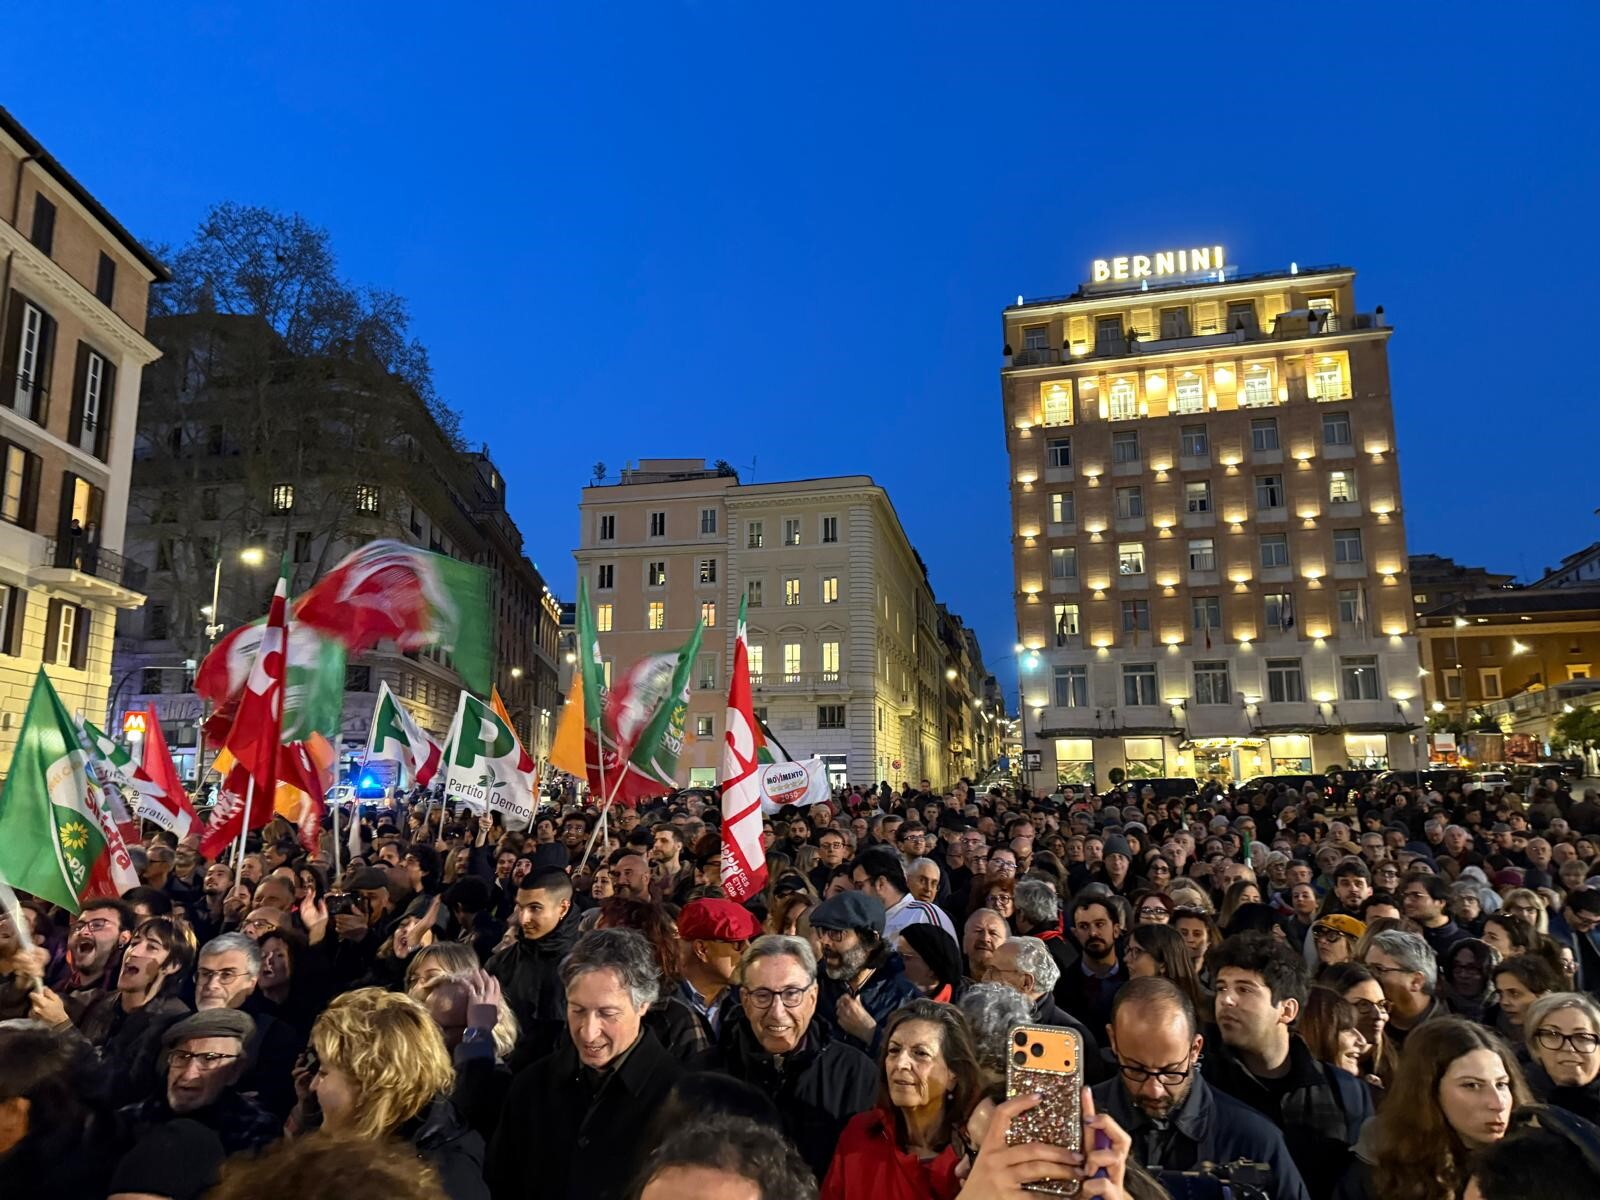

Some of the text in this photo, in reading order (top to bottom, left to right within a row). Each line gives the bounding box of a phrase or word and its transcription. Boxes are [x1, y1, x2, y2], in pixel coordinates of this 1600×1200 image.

[1093, 246, 1223, 282] BERNINI
[125, 714, 146, 728] M
[767, 770, 804, 785] MOVIMENTO
[449, 778, 484, 799] Partito
